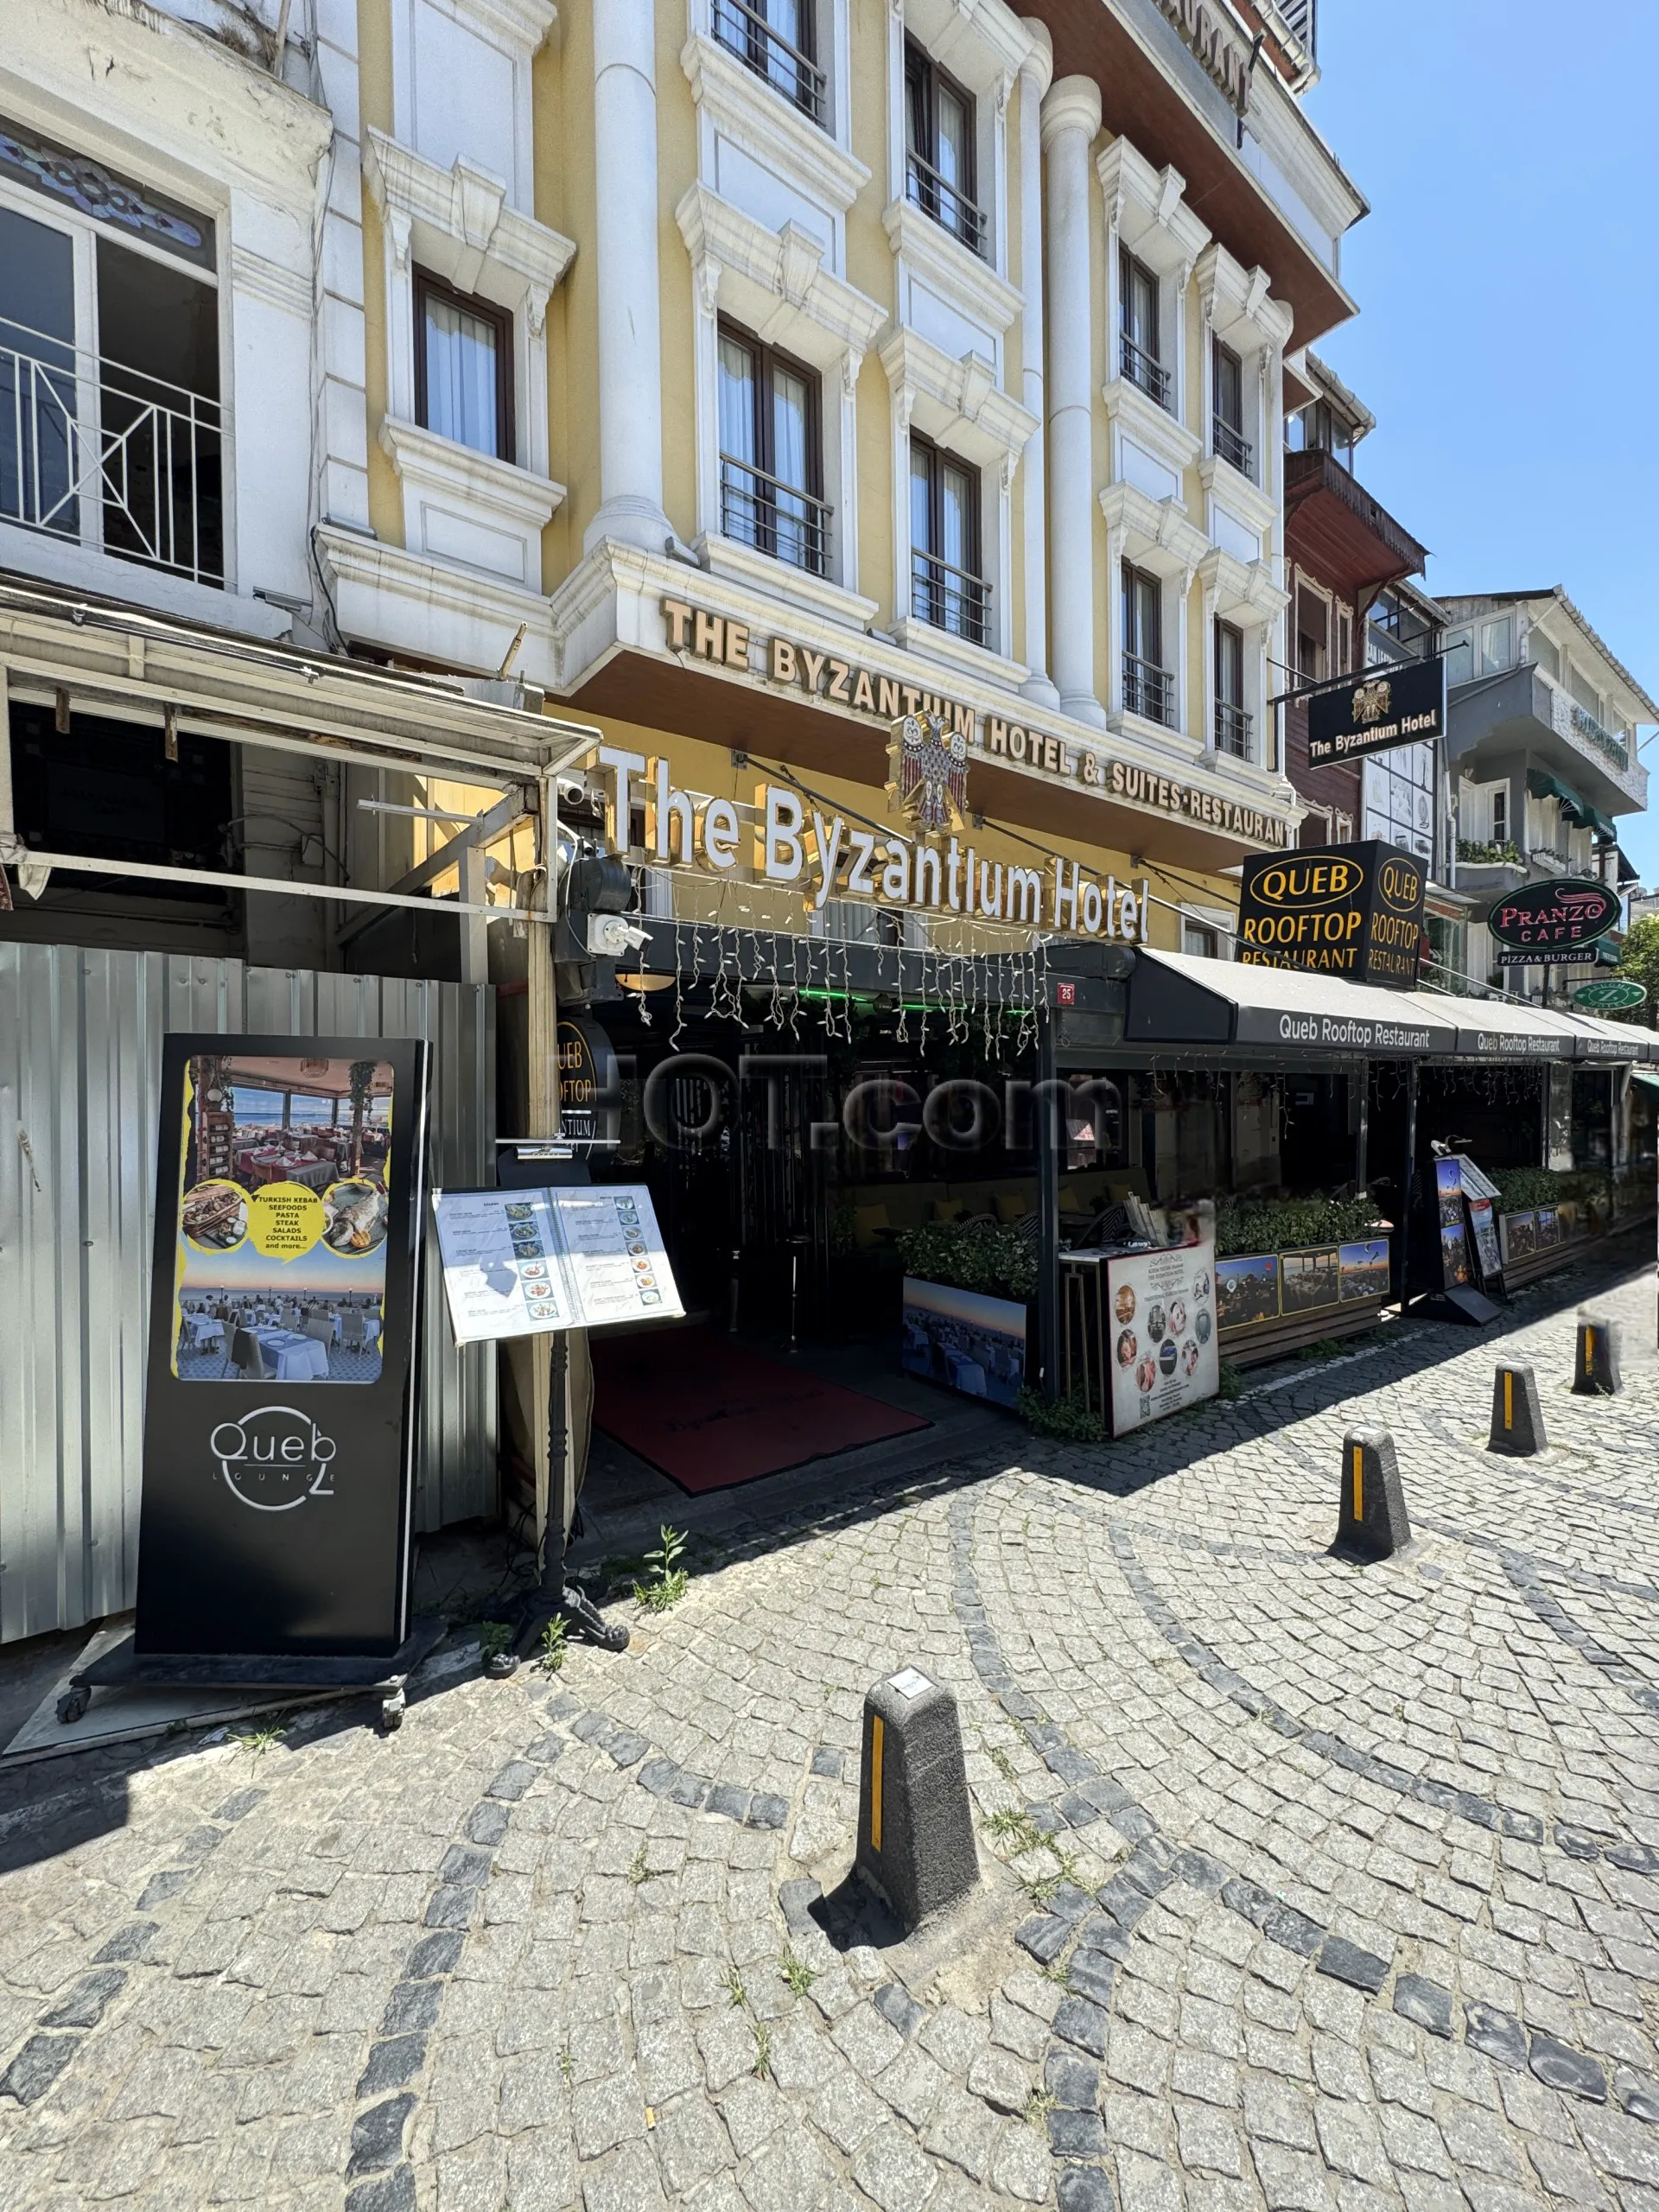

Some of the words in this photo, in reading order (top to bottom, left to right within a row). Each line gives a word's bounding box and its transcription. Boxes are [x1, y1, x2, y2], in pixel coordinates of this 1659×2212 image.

[664, 599, 749, 668] THE
[990, 718, 1071, 776] HOTEL
[1083, 751, 1101, 785] &
[1310, 740, 1332, 758] The
[1336, 722, 1398, 753] Byzantium
[1402, 709, 1436, 734] Hotel
[599, 745, 741, 869] The
[766, 785, 1042, 924] Byzantium
[1054, 856, 1149, 944] Hotel
[1262, 865, 1350, 901] QUEB
[1383, 866, 1418, 902] QUEB
[1243, 911, 1363, 944] ROOFTOP
[1371, 912, 1419, 950] ROOFTOP
[1500, 904, 1603, 928] PRANZO
[1521, 925, 1582, 943] CAFE
[1062, 988, 1071, 1000] 25
[1279, 1014, 1318, 1040] Queb
[1322, 1018, 1372, 1047] Rooftop
[1375, 1023, 1430, 1048] Restaurant
[1478, 1033, 1497, 1051] Queb
[1499, 1034, 1527, 1054] Rooftop
[1528, 1035, 1560, 1052] Restaurant
[556, 1040, 582, 1071] UEB
[210, 1422, 337, 1462] Queb
[213, 1471, 336, 1483] LOUNGE
